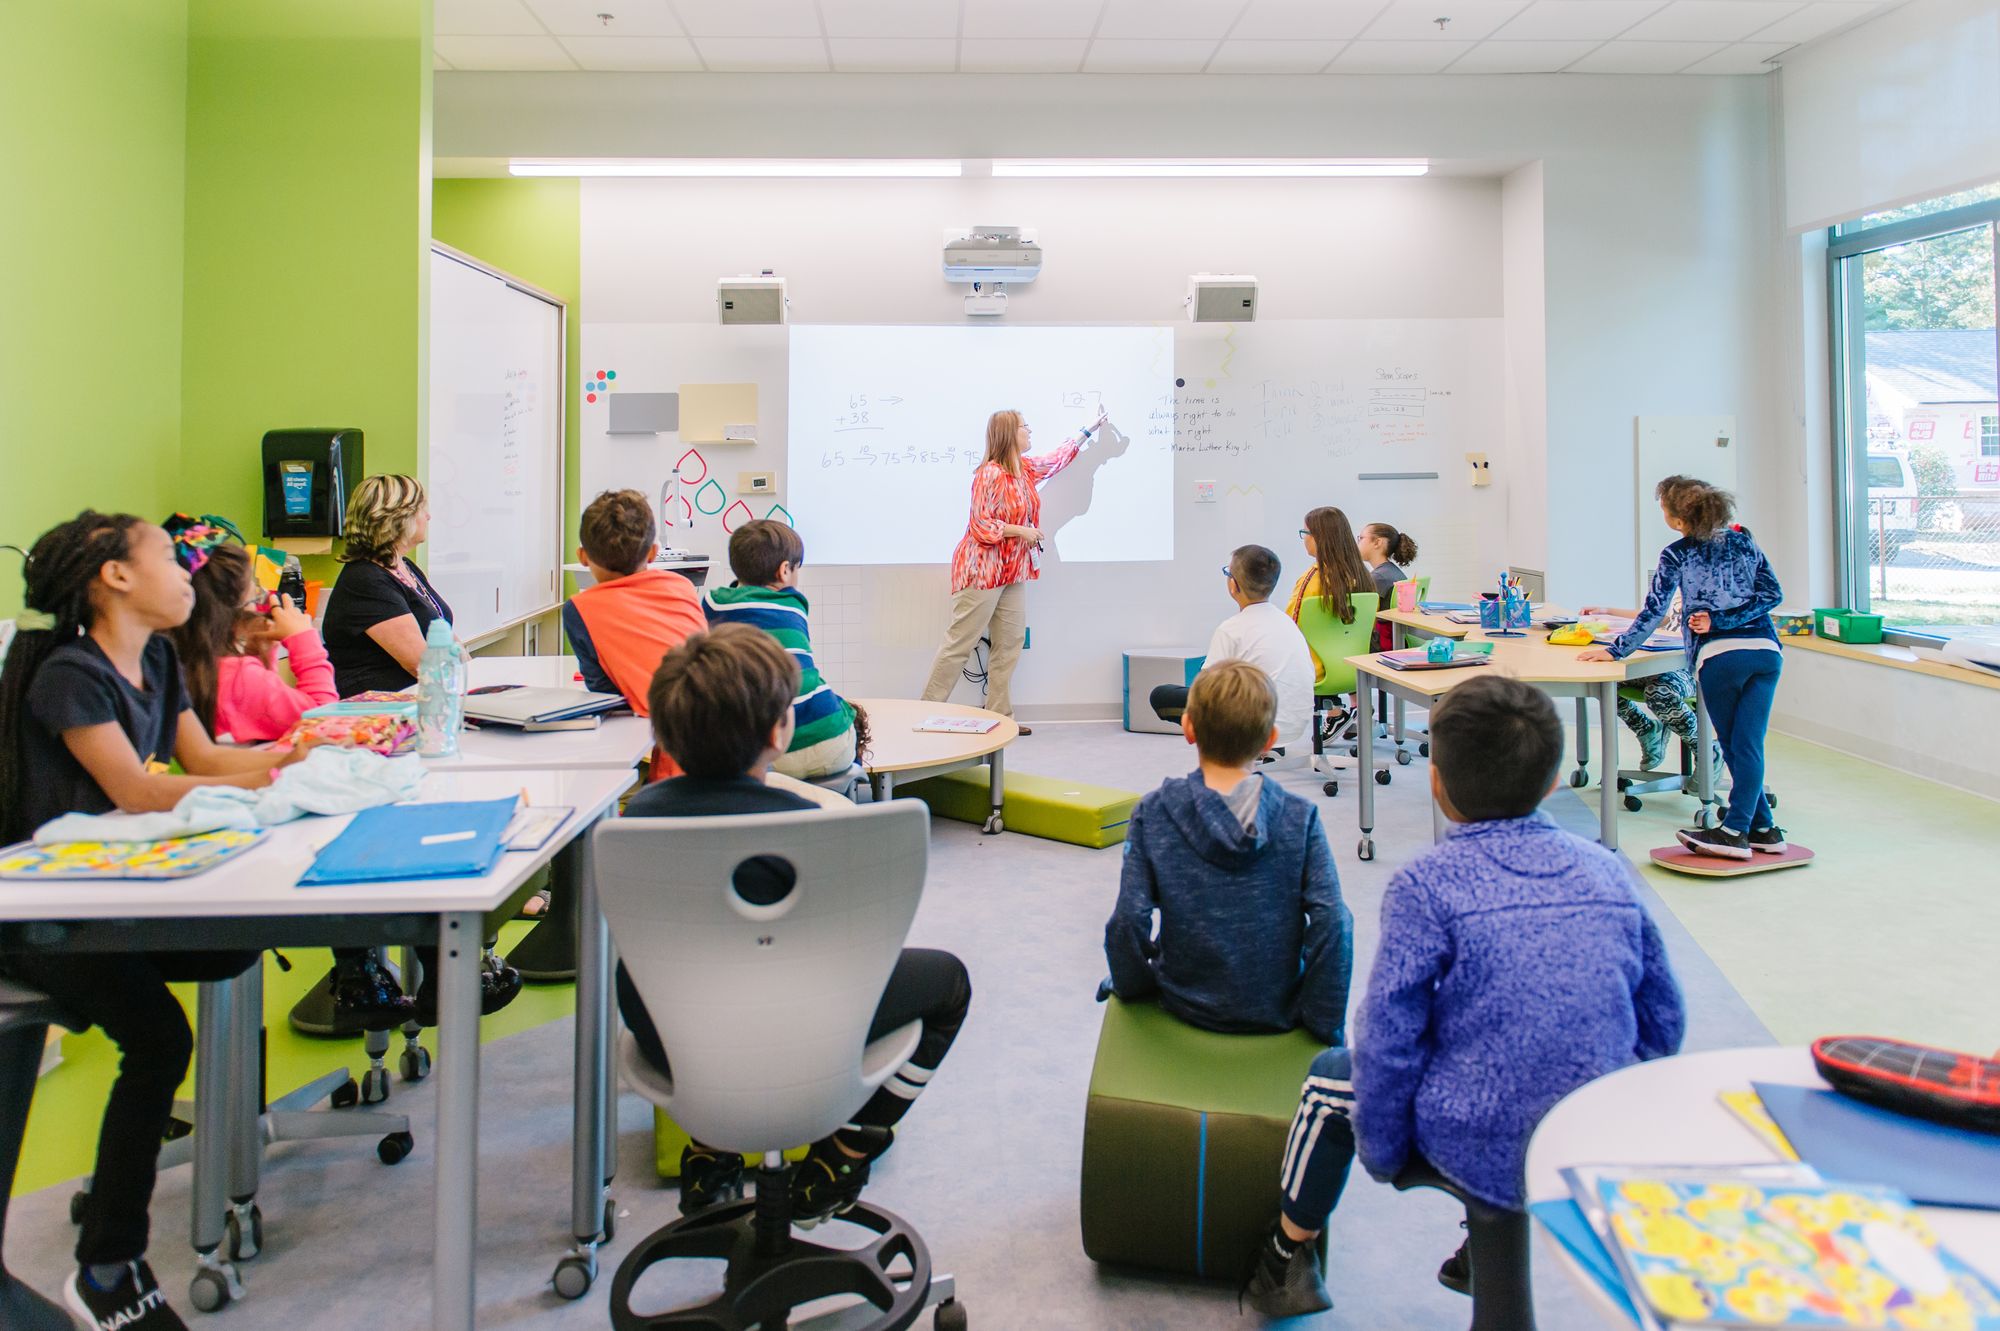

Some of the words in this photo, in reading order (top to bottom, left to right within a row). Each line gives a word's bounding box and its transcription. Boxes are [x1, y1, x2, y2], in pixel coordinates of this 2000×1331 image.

[849, 394, 868, 409] 65
[1158, 395, 1180, 406] The
[1185, 396, 1205, 404] time
[1149, 408, 1179, 424] always
[1183, 411, 1208, 425] right
[1211, 408, 1222, 417] to
[1226, 408, 1236, 417] do
[1148, 425, 1171, 435] what
[1187, 424, 1212, 441] right
[1199, 441, 1222, 452] Luther
[1226, 440, 1240, 456] King
[821, 449, 845, 468] 65
[881, 451, 900, 465] 75
[920, 451, 940, 464] 85
[963, 450, 982, 465] 95
